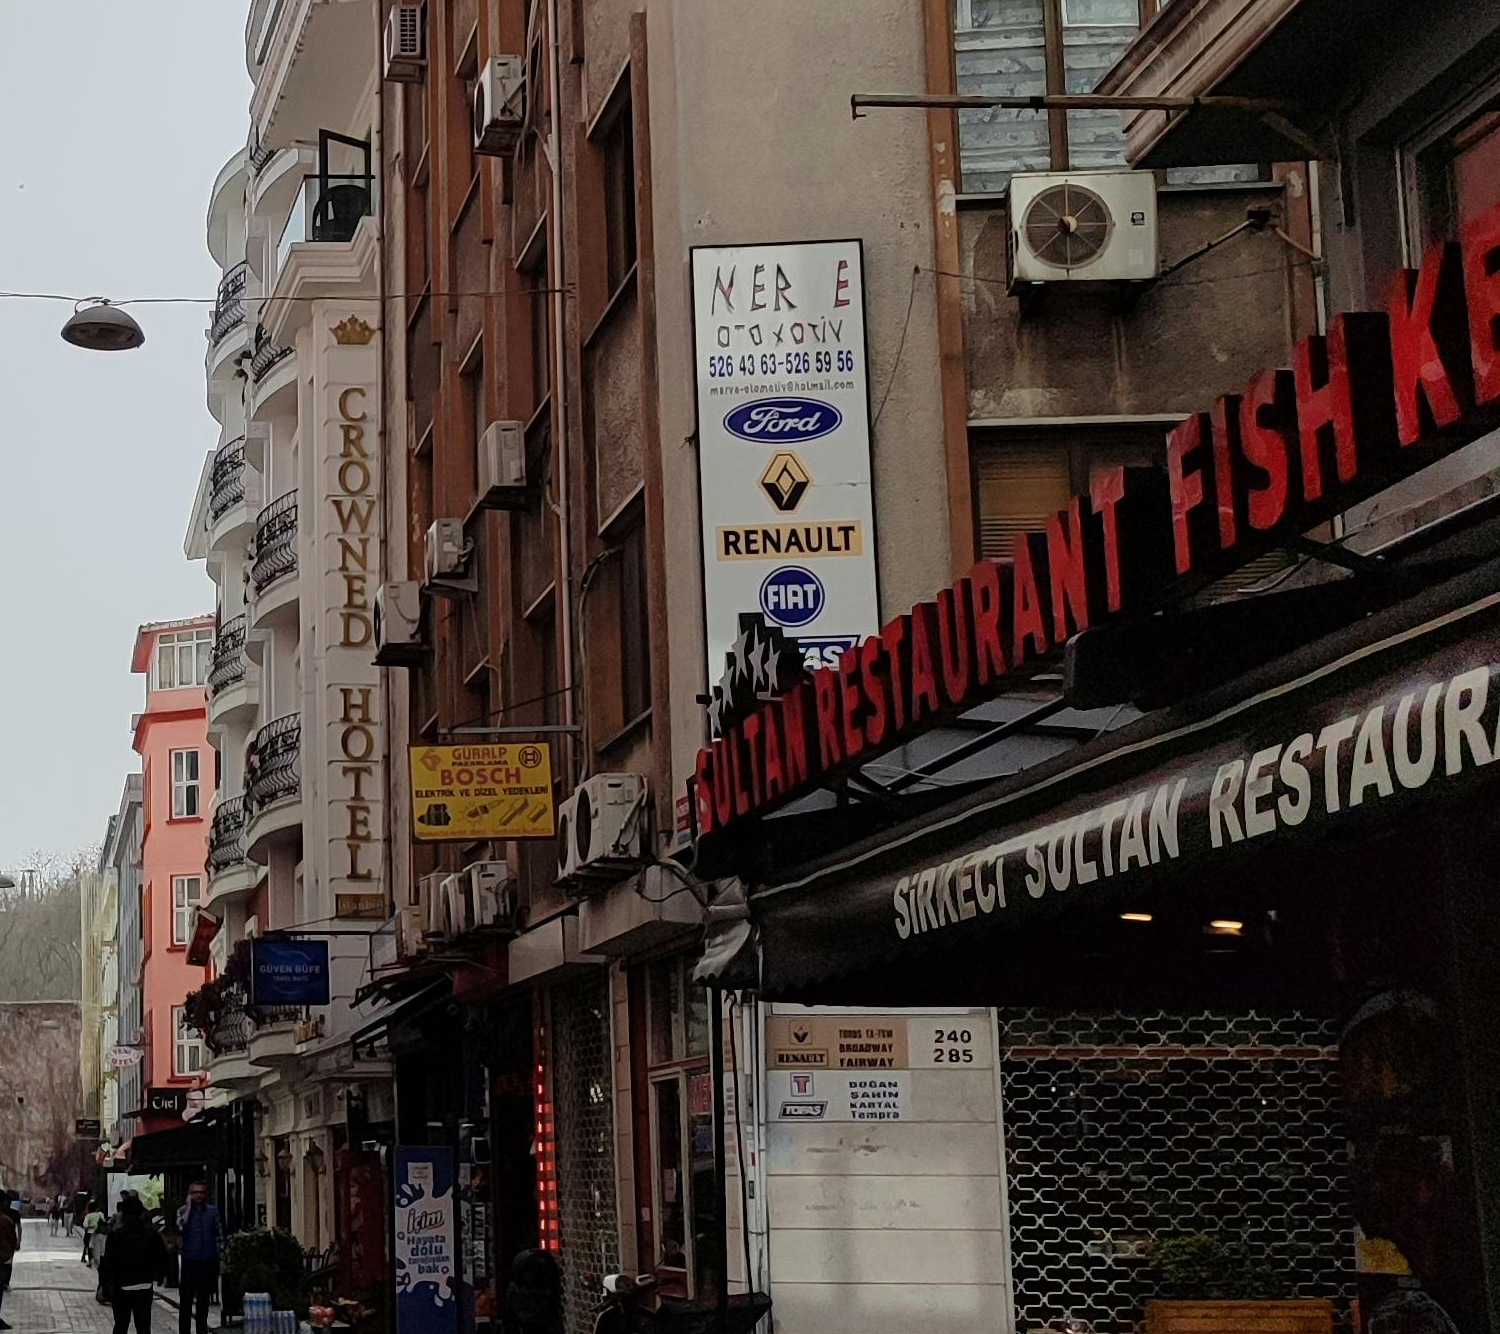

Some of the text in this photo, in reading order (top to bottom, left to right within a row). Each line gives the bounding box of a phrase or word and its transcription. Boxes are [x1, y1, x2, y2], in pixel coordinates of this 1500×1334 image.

[709, 355, 734, 378] 526
[740, 354, 756, 376] 43
[815, 351, 831, 373] 59
[837, 350, 854, 372] 56
[742, 406, 820, 434] Ford
[722, 525, 856, 556] RENAULT
[694, 681, 809, 838] SULTAN
[812, 465, 1125, 773] RESTAURANT
[1165, 310, 1359, 573] FISH
[766, 582, 817, 611] FIAT
[331, 386, 376, 880] CROWNED HOTEL
[440, 767, 522, 786] BOSCH
[1024, 777, 1188, 899] SULTAN
[1209, 663, 1500, 849] RESTAUR
[459, 788, 471, 797] VE
[474, 787, 498, 797] DİZEL
[934, 1029, 972, 1044] 240
[778, 1053, 826, 1063] RENAULT
[839, 1058, 895, 1068] FAIRWAY
[933, 1048, 974, 1063] 285
[410, 1244, 443, 1257] dolu
[417, 1263, 436, 1275] bak
